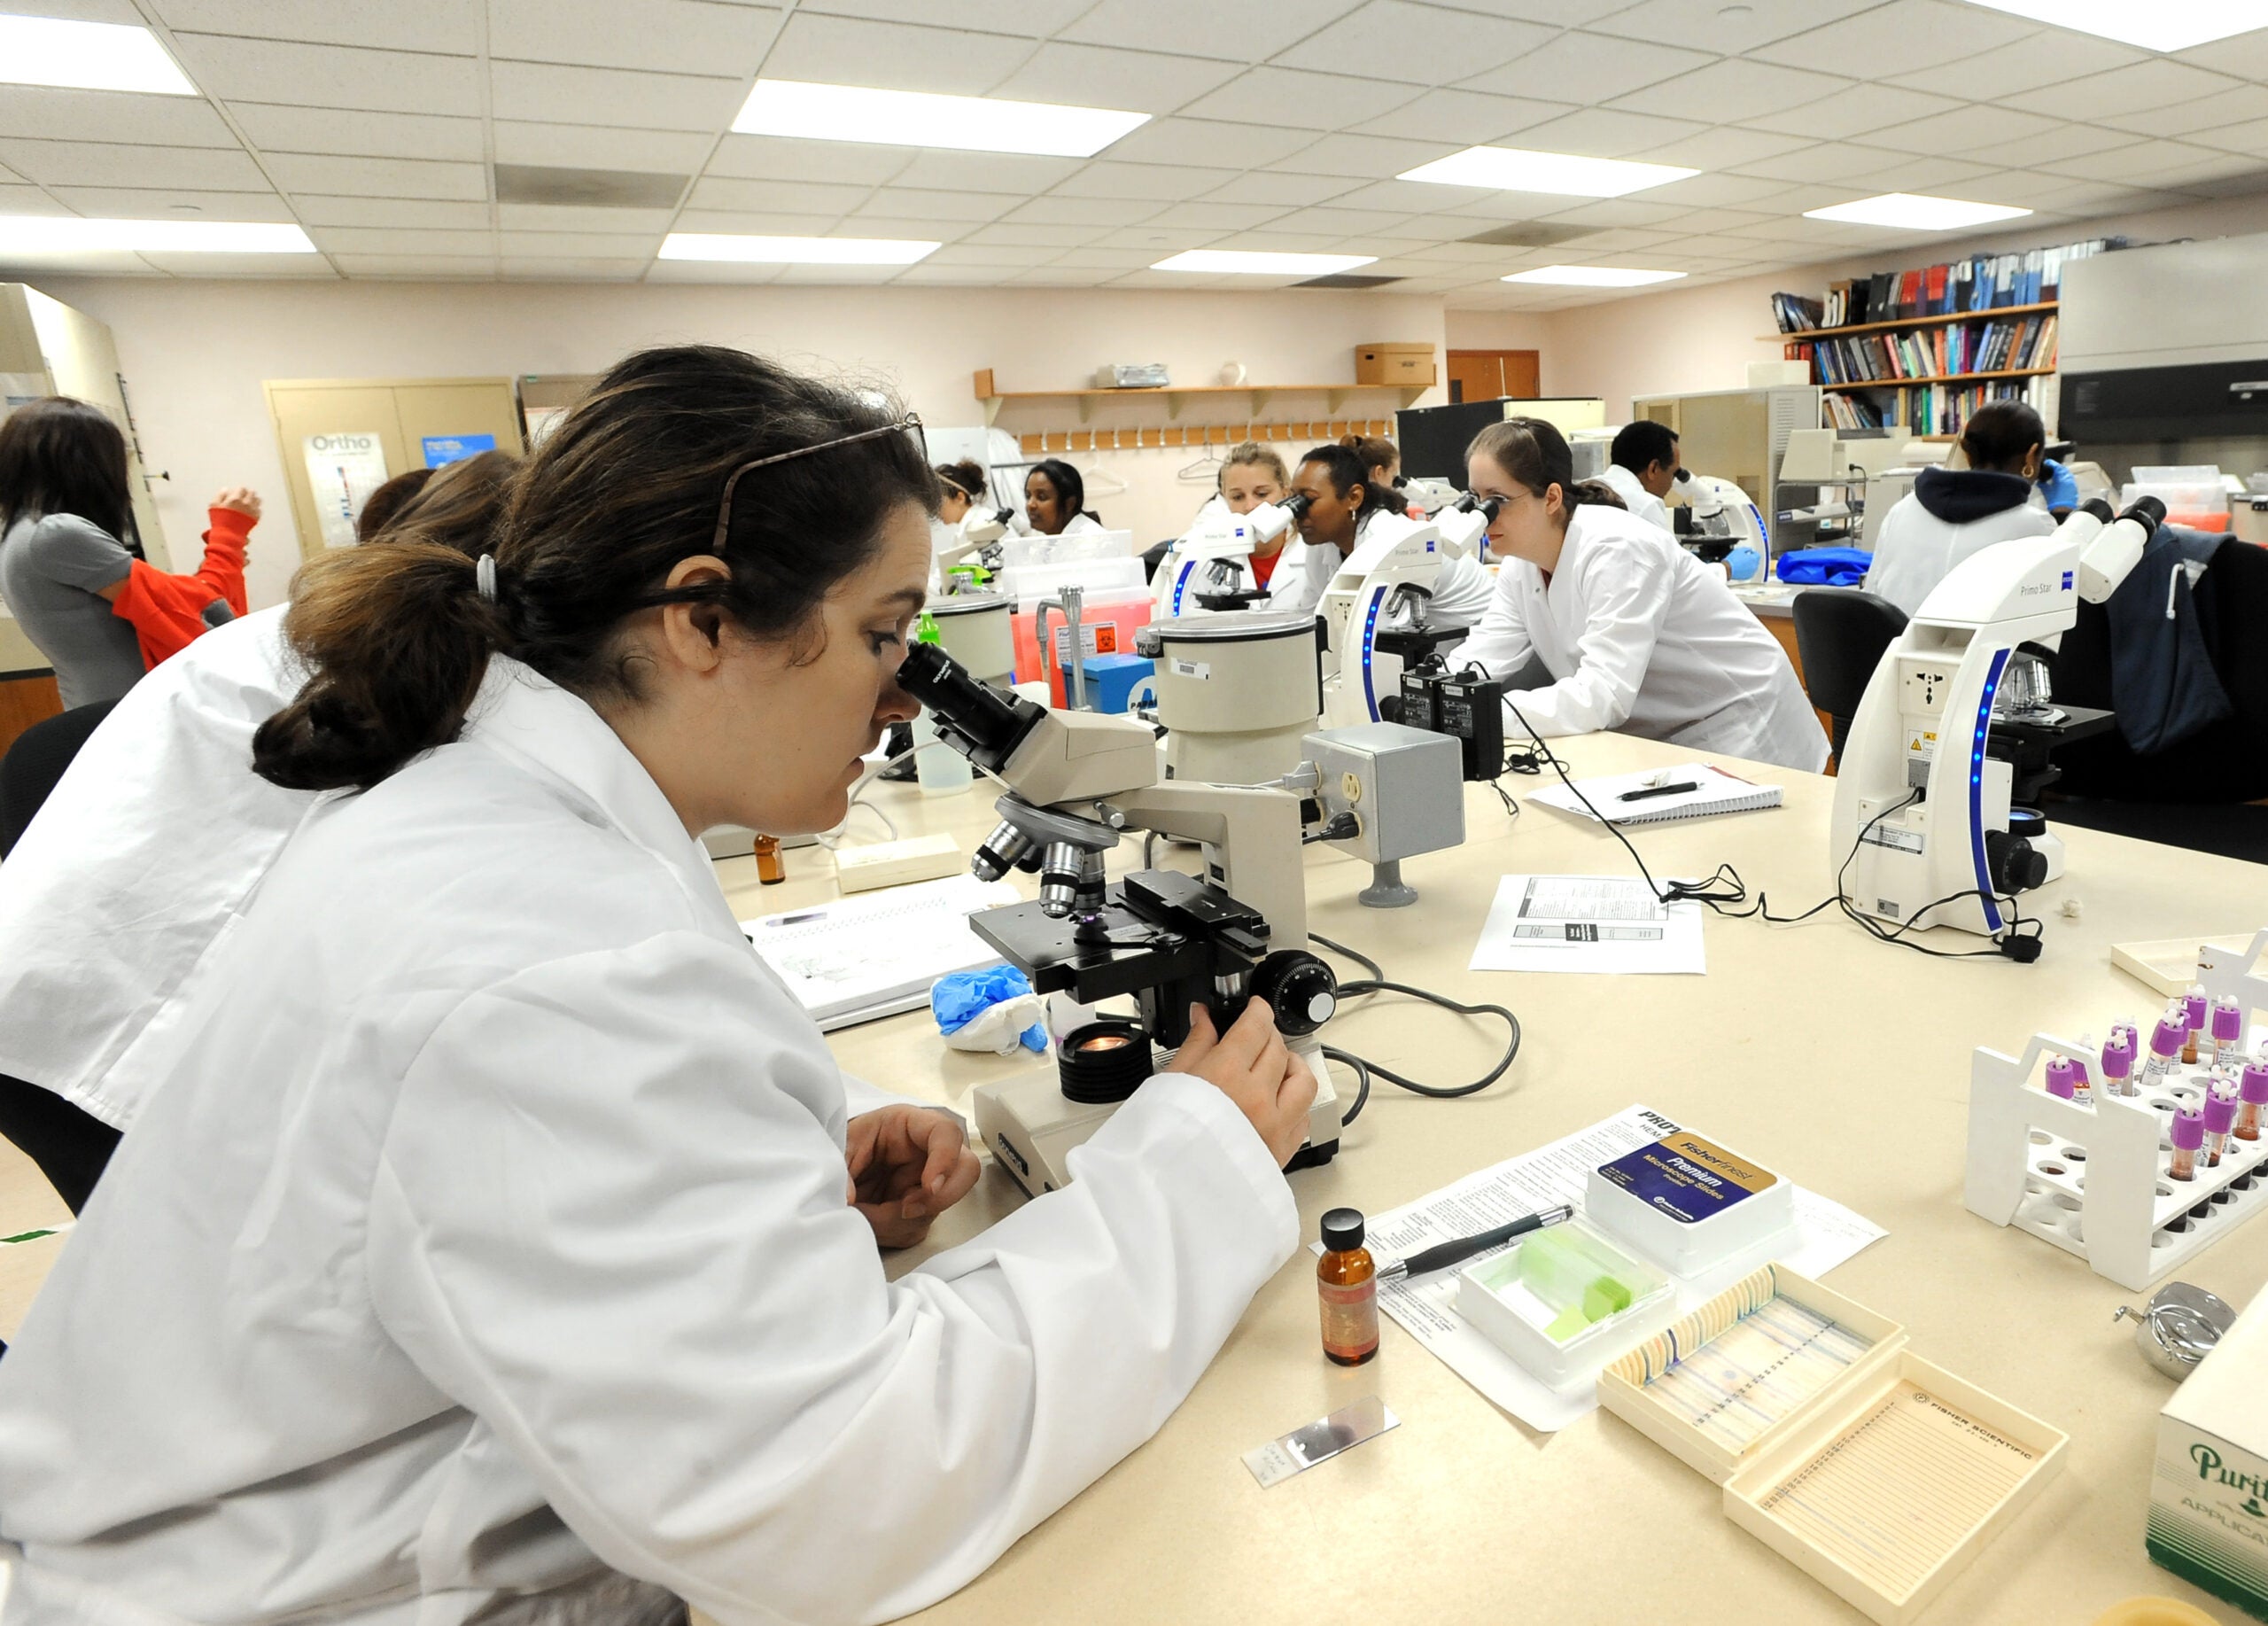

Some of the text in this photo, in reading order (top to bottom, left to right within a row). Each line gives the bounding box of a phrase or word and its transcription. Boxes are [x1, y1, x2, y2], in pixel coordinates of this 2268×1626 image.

[312, 435, 371, 451] Ortho
[2021, 583, 2052, 595] Primo Star
[1643, 1154, 1696, 1185] Microscope
[1694, 1181, 1724, 1200] Slides
[1666, 1155, 1723, 1188] Premium
[1930, 1403, 1969, 1426] FISHER
[1971, 1424, 2032, 1460] SCIENTIFIC
[2181, 1497, 2268, 1545] APPLICA
